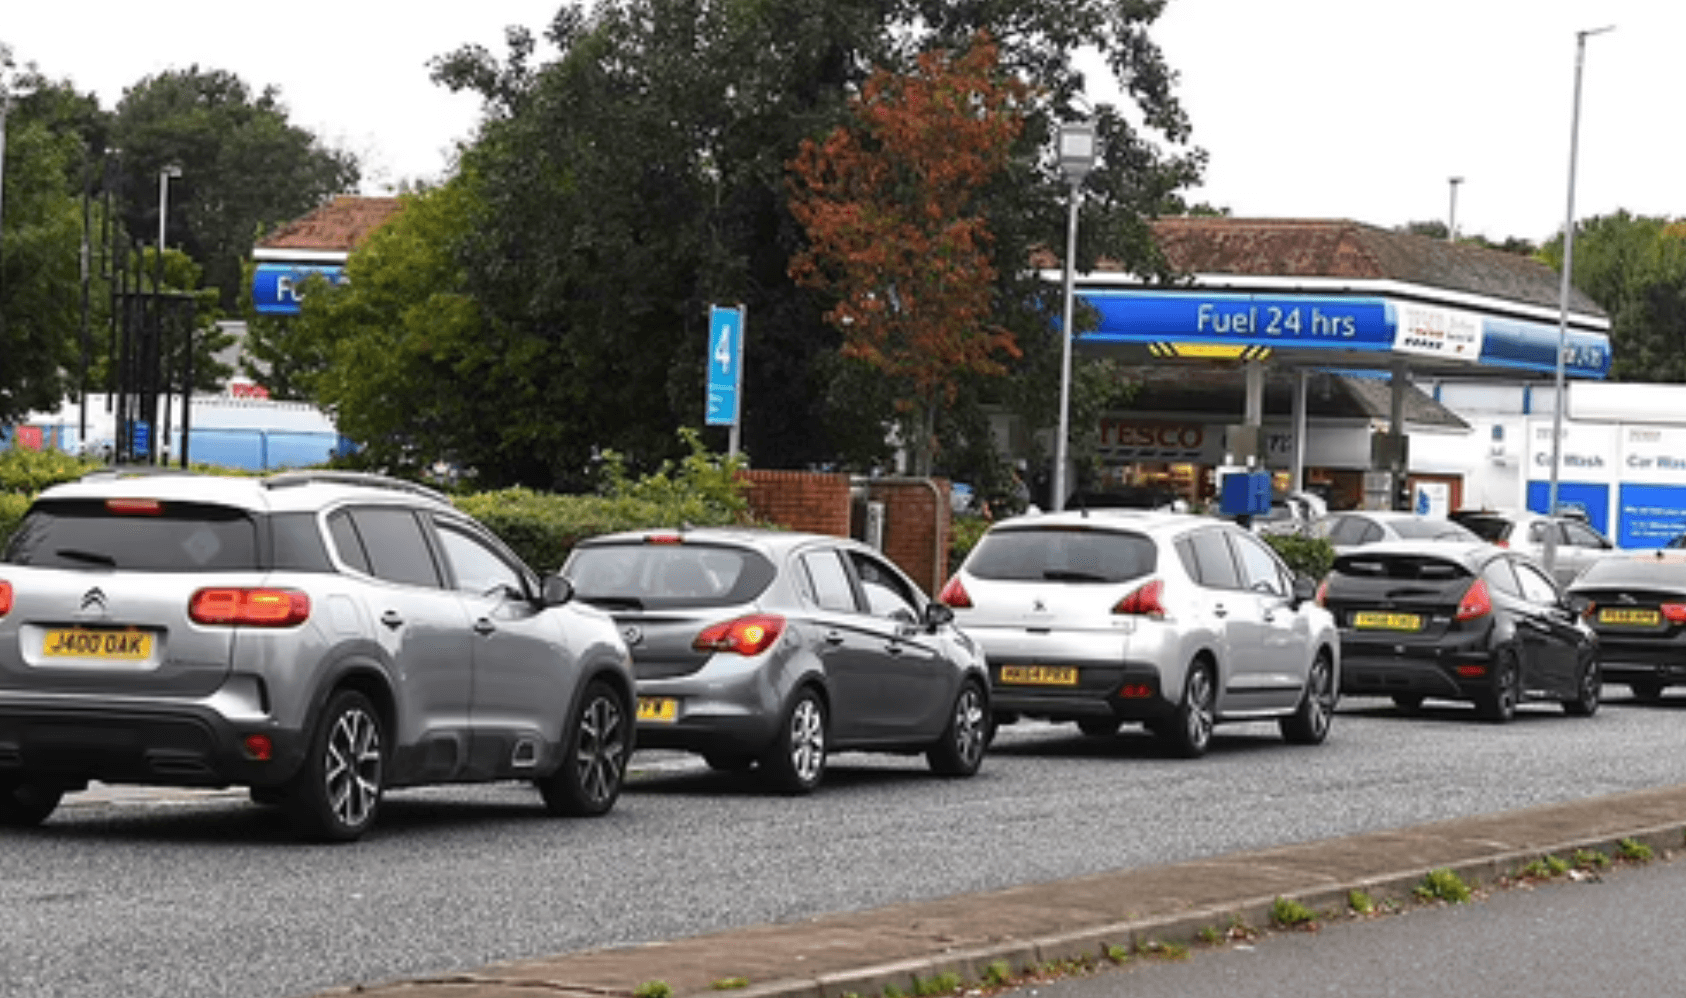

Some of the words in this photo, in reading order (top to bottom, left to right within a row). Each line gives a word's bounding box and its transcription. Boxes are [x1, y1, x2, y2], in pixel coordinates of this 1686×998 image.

[1197, 303, 1257, 333] Fuel
[1266, 305, 1303, 335] 24
[1311, 307, 1356, 336] hrs
[714, 323, 731, 374] 4
[1100, 417, 1203, 449] TESCO
[1562, 454, 1605, 470] Wash
[1626, 453, 1653, 469] Car
[1656, 454, 1686, 471] Was
